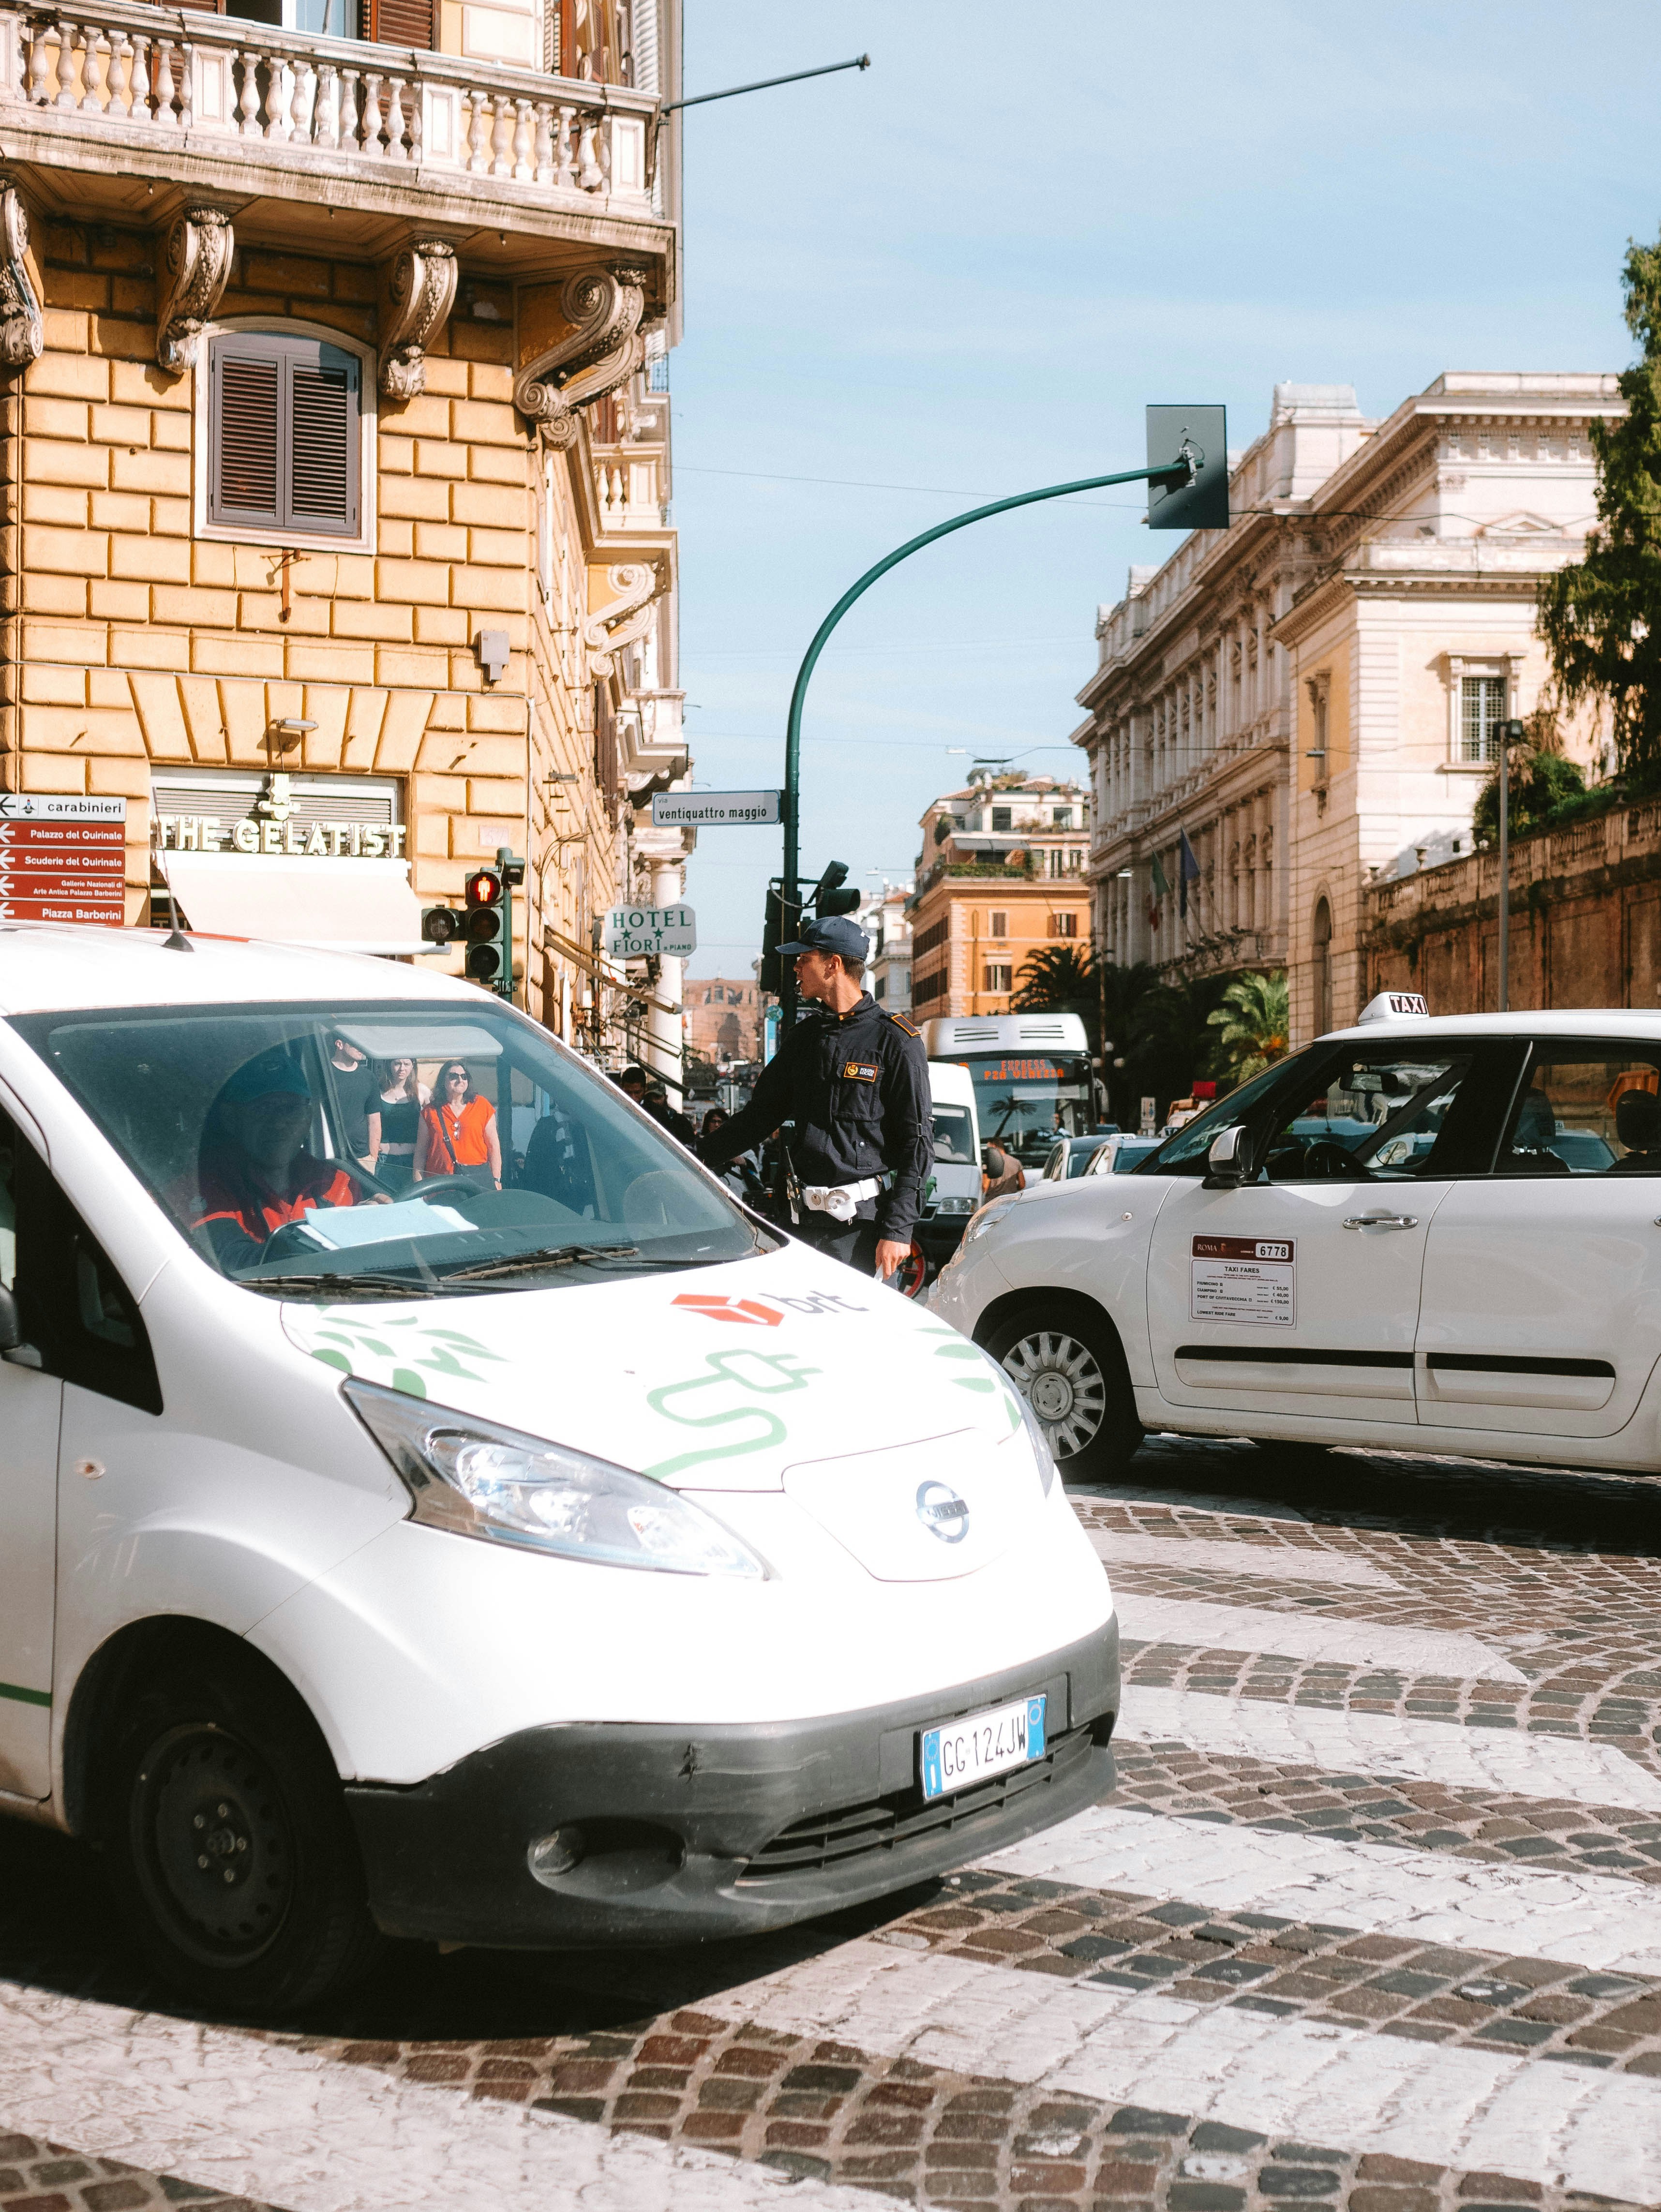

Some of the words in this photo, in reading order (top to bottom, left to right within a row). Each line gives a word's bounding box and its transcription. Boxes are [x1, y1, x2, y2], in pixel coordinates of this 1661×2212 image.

[48, 802, 121, 813] carabinieri
[659, 807, 725, 822] ventiquattro
[729, 805, 767, 820] maggio
[30, 829, 63, 839] Palazzo
[66, 830, 79, 839] del
[82, 830, 122, 840] Quirinale
[150, 815, 221, 852] THE
[232, 819, 406, 857] GELATIST
[25, 856, 63, 865] Scuderie
[66, 857, 79, 866] del
[82, 857, 122, 867] Quirinale
[42, 908, 73, 918] Piazza
[76, 909, 121, 920] Barberini
[613, 911, 692, 929] HOTEL
[614, 939, 660, 953] FIORI
[1390, 996, 1426, 1013] TAXI
[1001, 1059, 1046, 1071] EXPRESS
[984, 1070, 1006, 1080] PZA
[1013, 1068, 1064, 1079] VENEZIA
[1260, 1246, 1286, 1256] 6778
